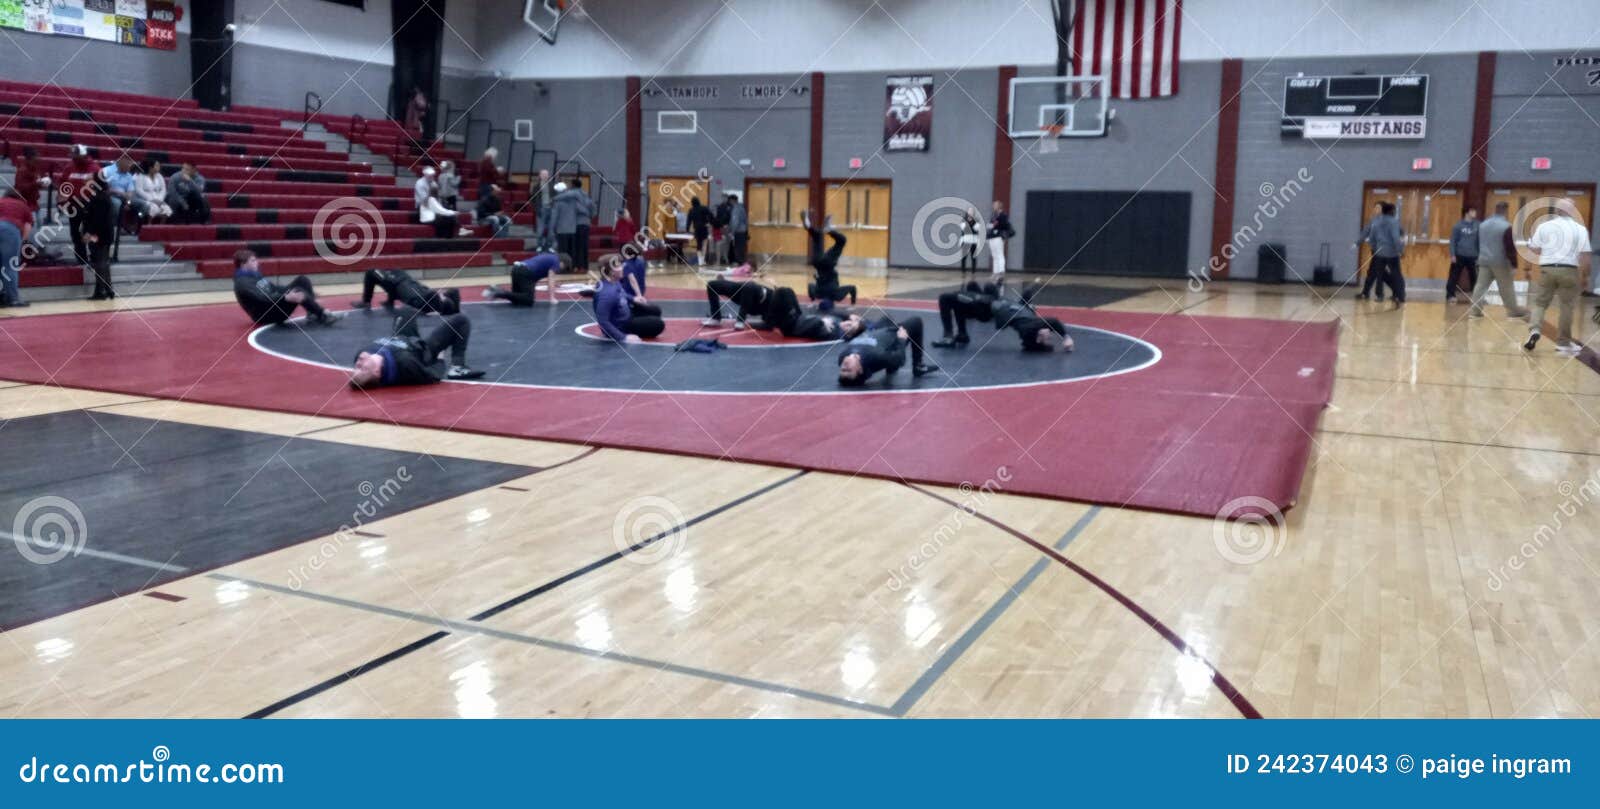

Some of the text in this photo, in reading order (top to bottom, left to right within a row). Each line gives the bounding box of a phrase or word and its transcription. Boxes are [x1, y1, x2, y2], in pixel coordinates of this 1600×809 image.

[1290, 78, 1322, 87] GUEST
[1390, 77, 1422, 86] HOME
[667, 85, 783, 98] STANHOPE ELMORE
[1326, 105, 1357, 113] PERIOD
[1340, 121, 1422, 135] MUSTANGS
